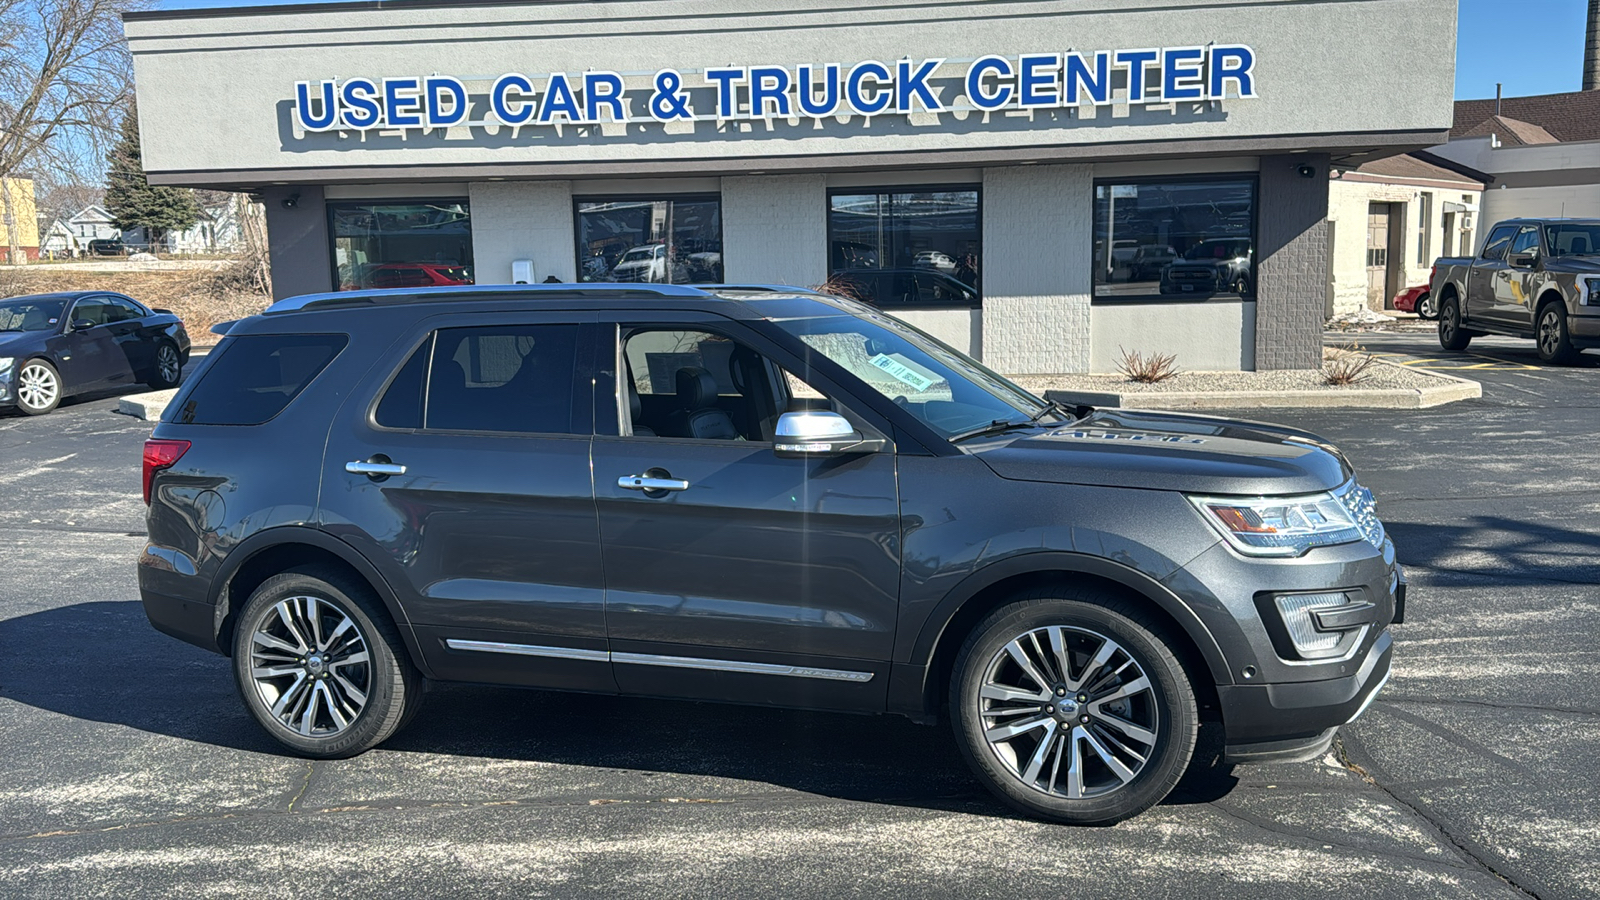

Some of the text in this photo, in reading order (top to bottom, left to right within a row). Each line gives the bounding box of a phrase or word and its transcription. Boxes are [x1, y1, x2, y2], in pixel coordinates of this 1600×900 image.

[295, 44, 1259, 132] USED CAR & TRUCK CENTER
